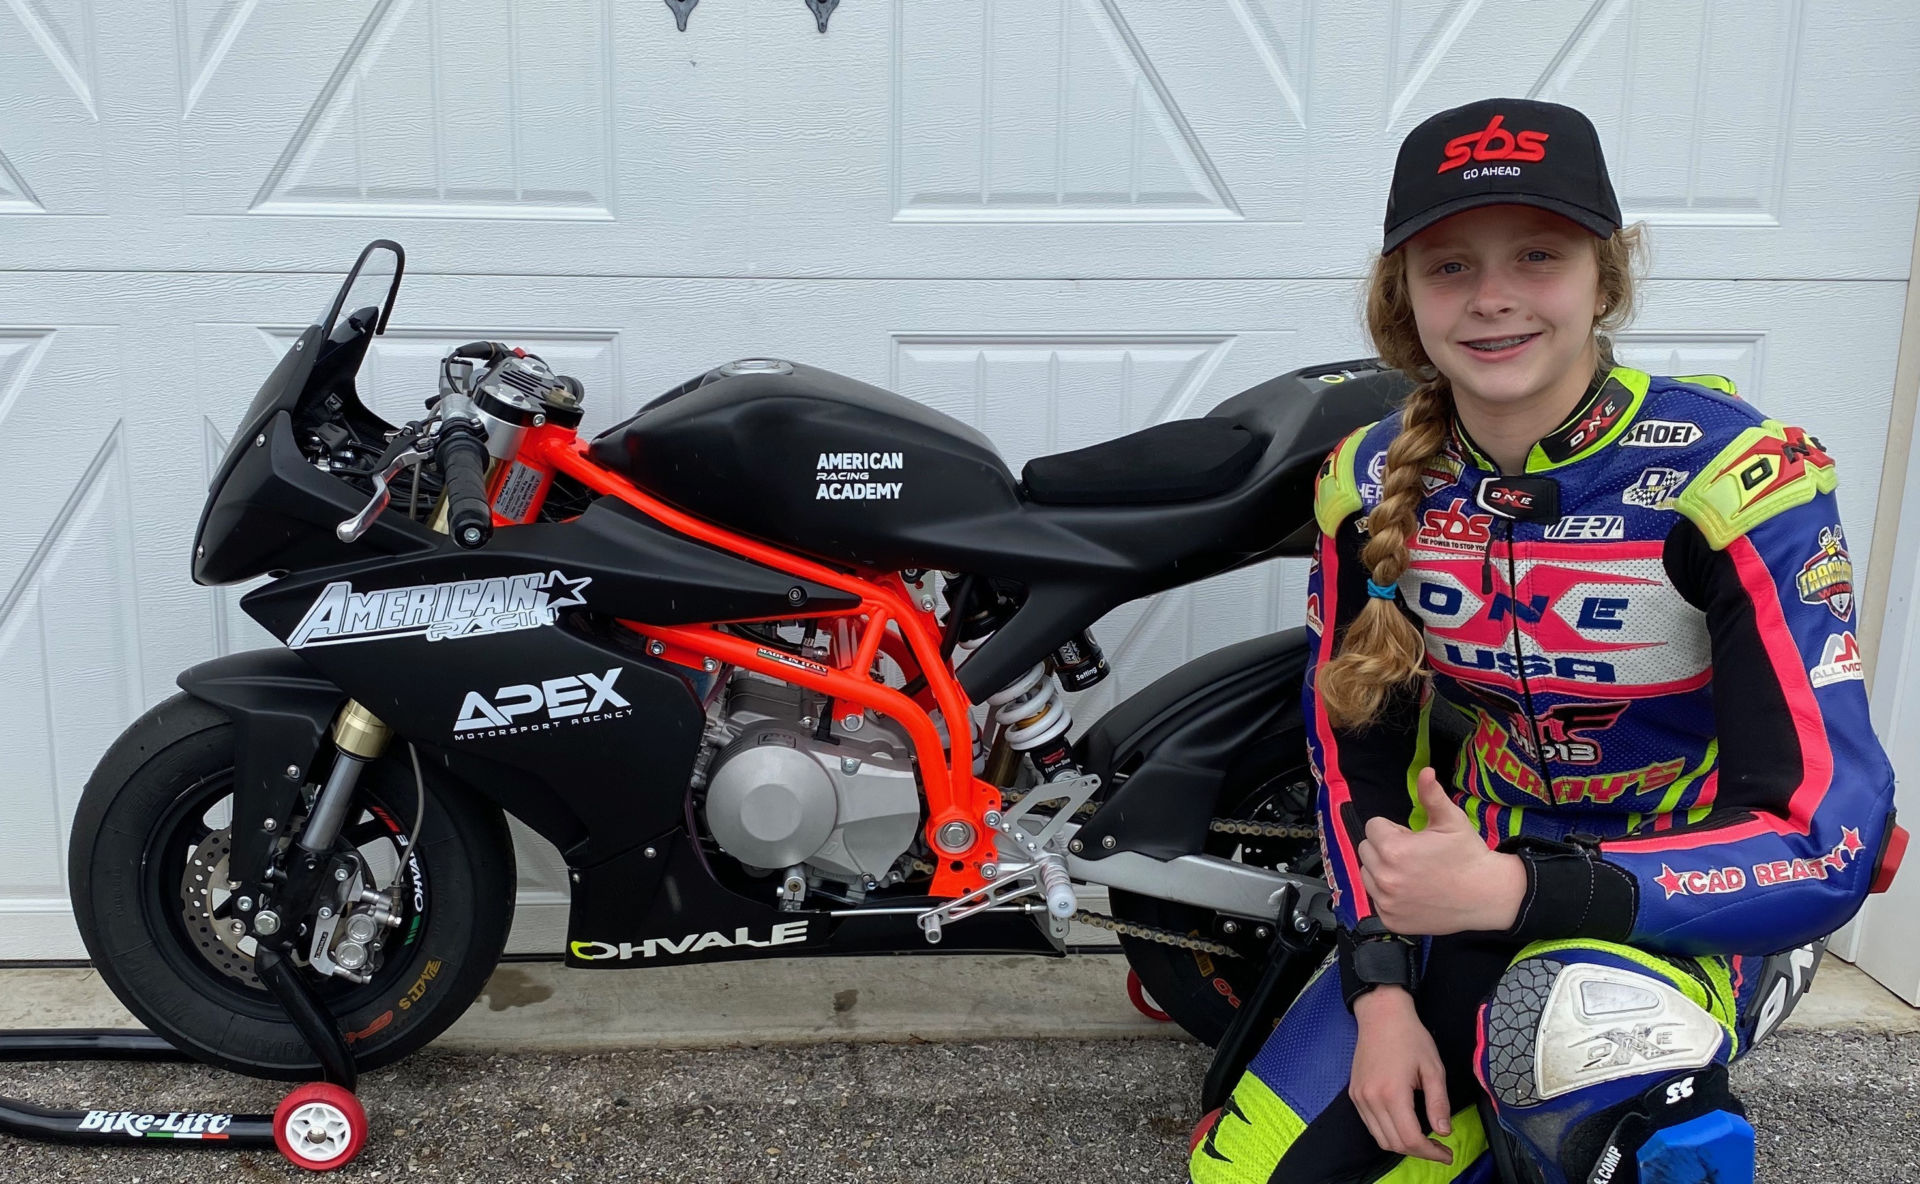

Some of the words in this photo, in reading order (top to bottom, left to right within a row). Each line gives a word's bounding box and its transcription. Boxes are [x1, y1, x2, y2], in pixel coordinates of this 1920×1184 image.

[1438, 115, 1550, 174] sbs
[1463, 168, 1479, 180] GO
[1481, 166, 1521, 177] AHEAD
[1570, 401, 1616, 448] ONE
[1622, 424, 1693, 444] SHOEI
[816, 452, 903, 470] AMERICAN
[816, 472, 870, 480] RACING
[816, 483, 903, 500] ACADEMY
[1491, 491, 1533, 505] ONE
[1420, 498, 1493, 543] sbs
[1430, 539, 1451, 548] POWER
[287, 573, 546, 648] AMERICAN
[1419, 581, 1630, 630] ONE
[428, 606, 557, 640] RACIN
[758, 648, 785, 660] MADE
[801, 660, 828, 673] ITALY
[1444, 643, 1616, 683] USA
[453, 667, 631, 731] APEX
[454, 721, 561, 741] MOTORSPORT
[396, 834, 424, 913] OHVAE
[1686, 867, 1746, 894] CAD
[570, 920, 809, 960] OHVALE
[78, 1110, 233, 1137] Bike-Lift
[1598, 1145, 1622, 1180] COMP
